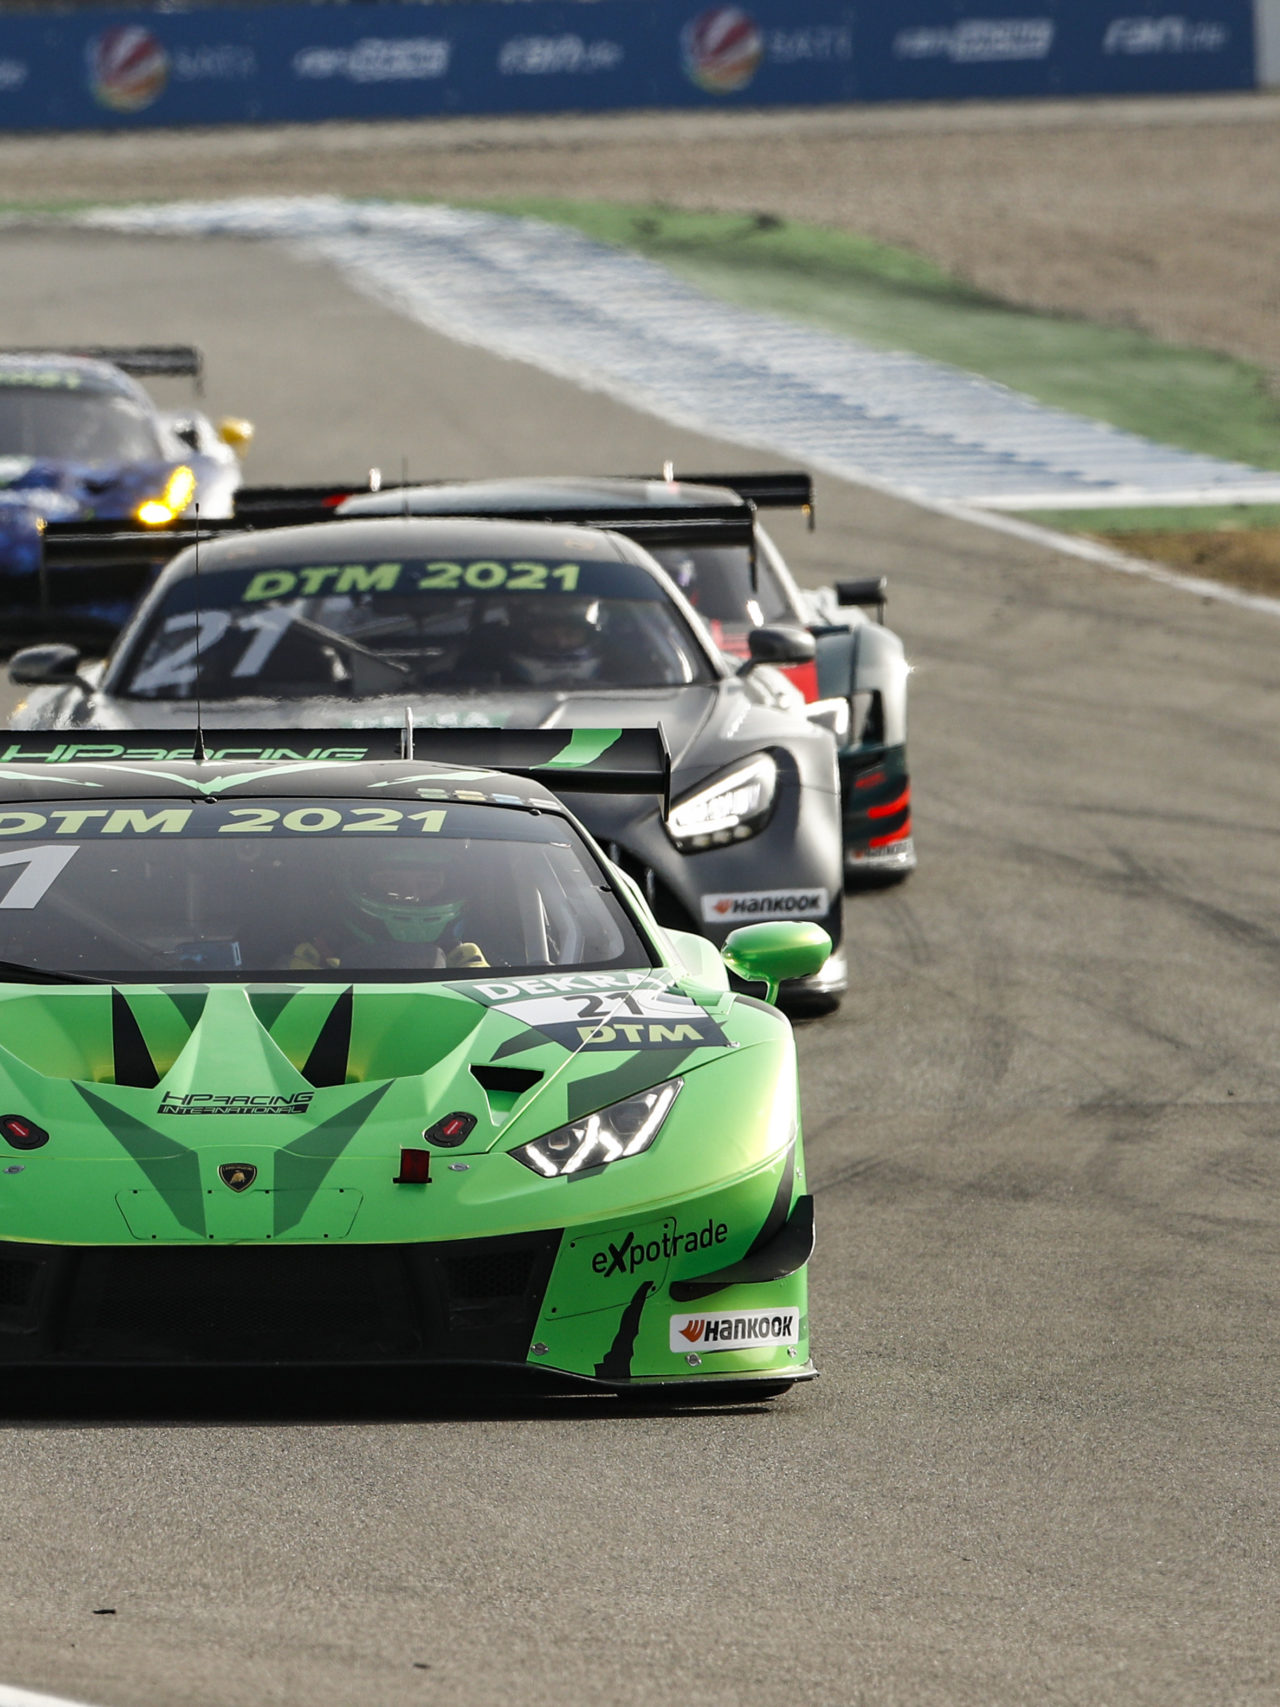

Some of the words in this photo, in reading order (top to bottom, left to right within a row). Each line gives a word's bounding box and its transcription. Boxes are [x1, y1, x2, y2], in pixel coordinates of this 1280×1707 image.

[242, 564, 402, 601] DTM
[420, 562, 580, 591] 2021
[130, 600, 310, 692] 21
[218, 807, 448, 833] 2021
[732, 895, 820, 913] HANKOOK
[472, 972, 654, 1000] DEKRA
[563, 991, 643, 1017] 21
[576, 1024, 704, 1043] DTM
[162, 1105, 302, 1114] INTERNATIONAL
[591, 1218, 728, 1277] eXpotrade
[703, 1316, 793, 1342] HANKOOK
